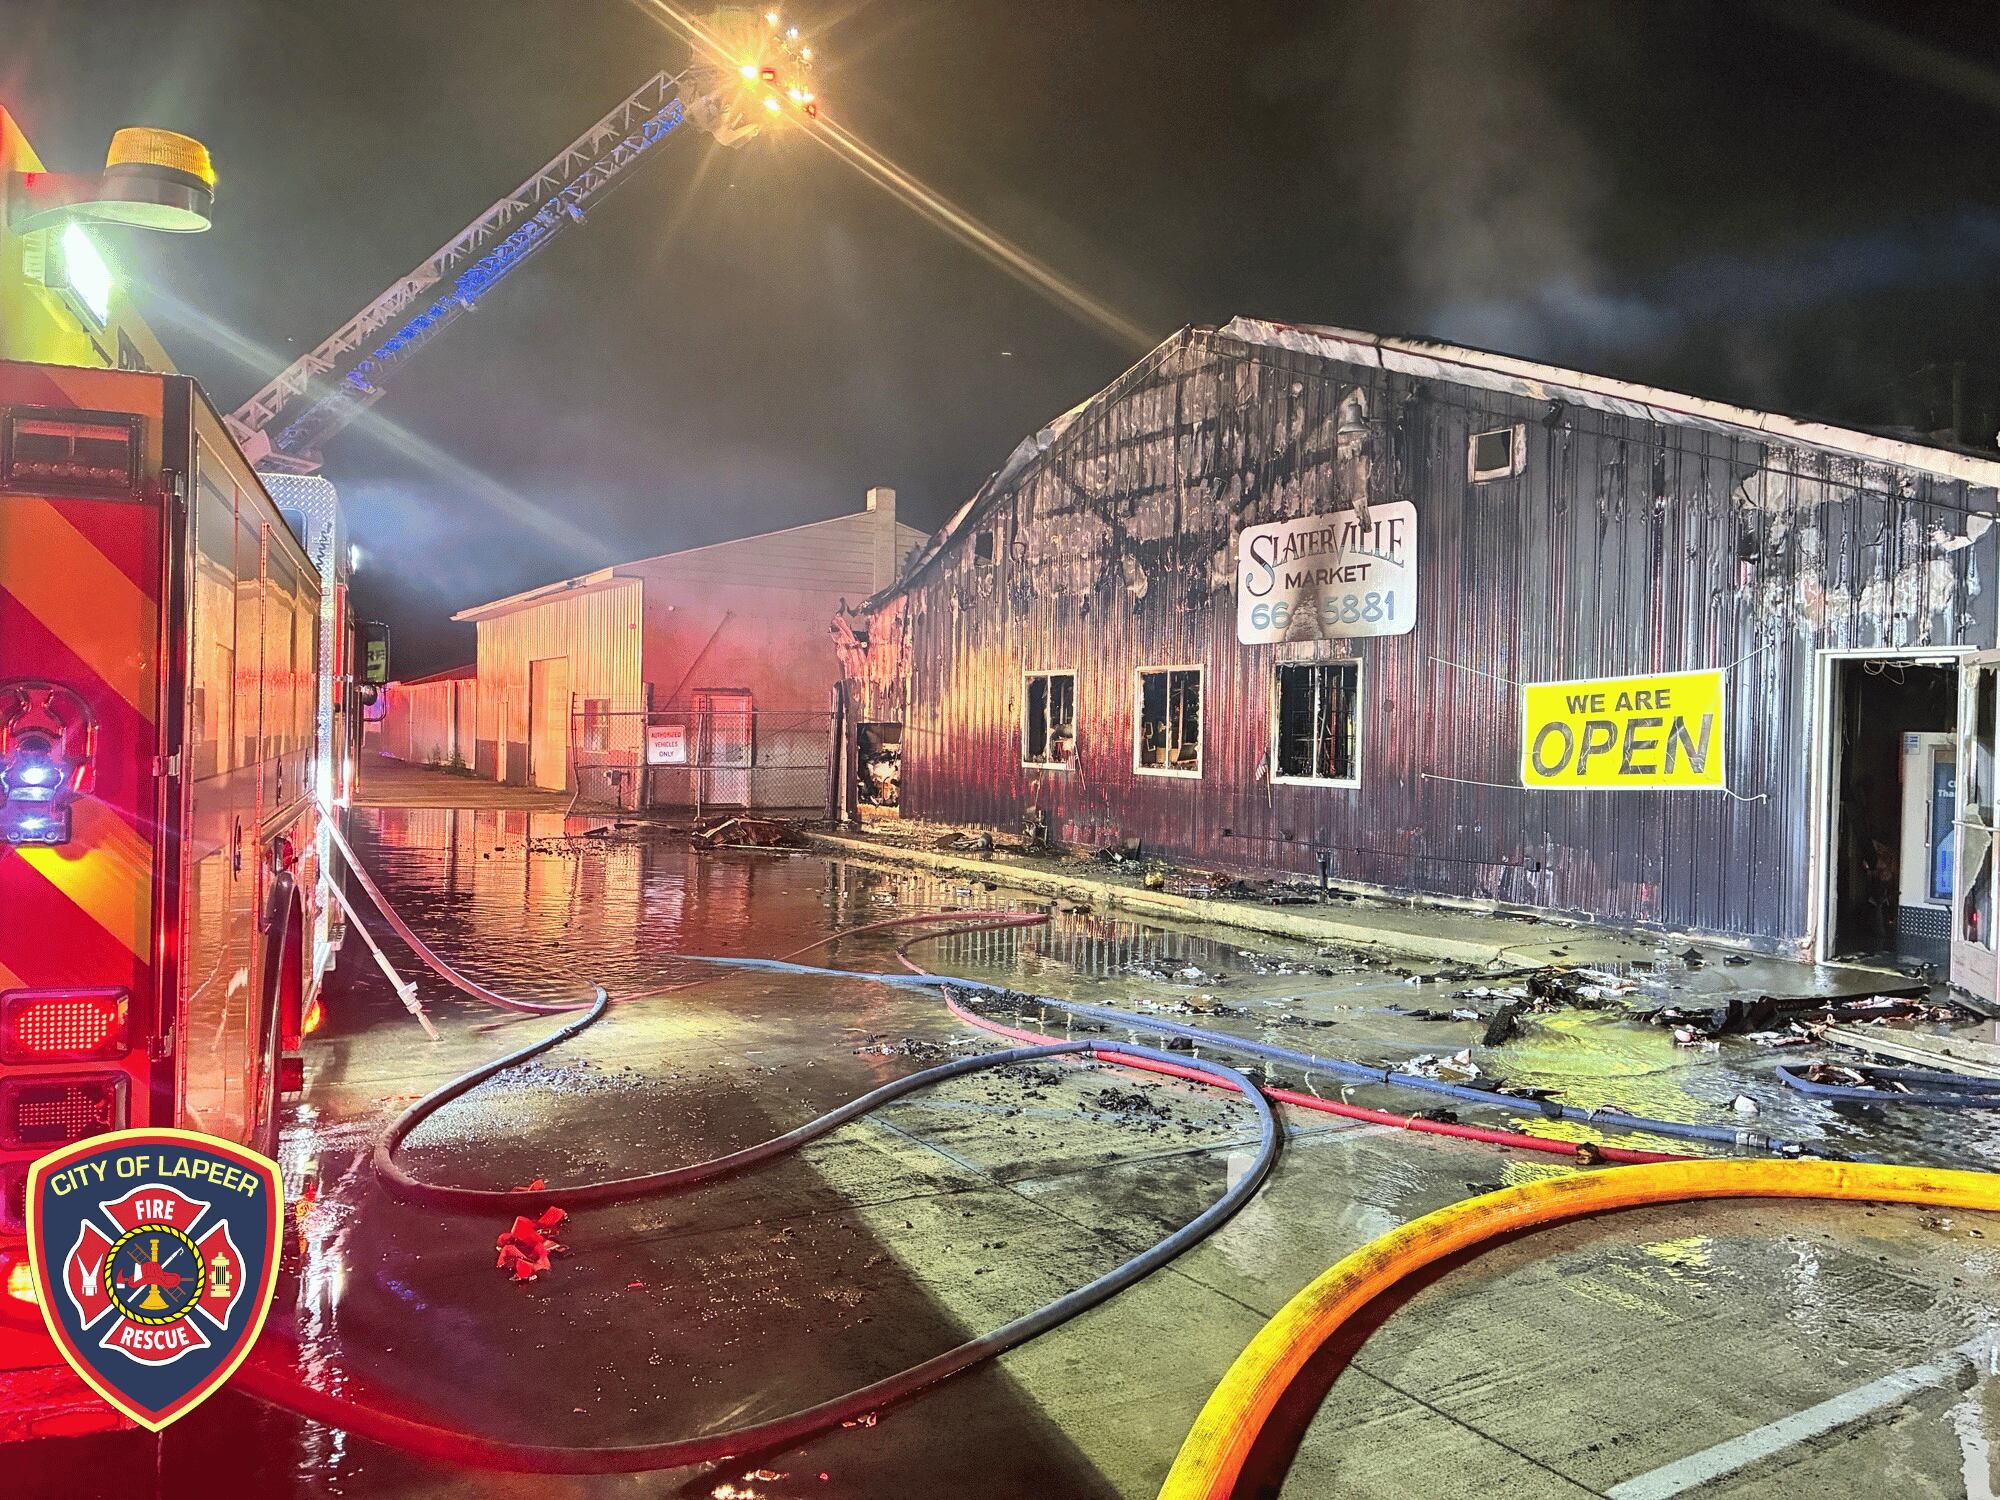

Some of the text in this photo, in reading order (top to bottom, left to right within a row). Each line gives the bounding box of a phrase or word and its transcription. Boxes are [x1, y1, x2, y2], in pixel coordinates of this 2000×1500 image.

[1246, 518, 1405, 596] SLATERVILLE
[1285, 563, 1371, 589] MARKET
[1566, 689, 1671, 714] WE ARE
[1532, 714, 1713, 777] OPEN
